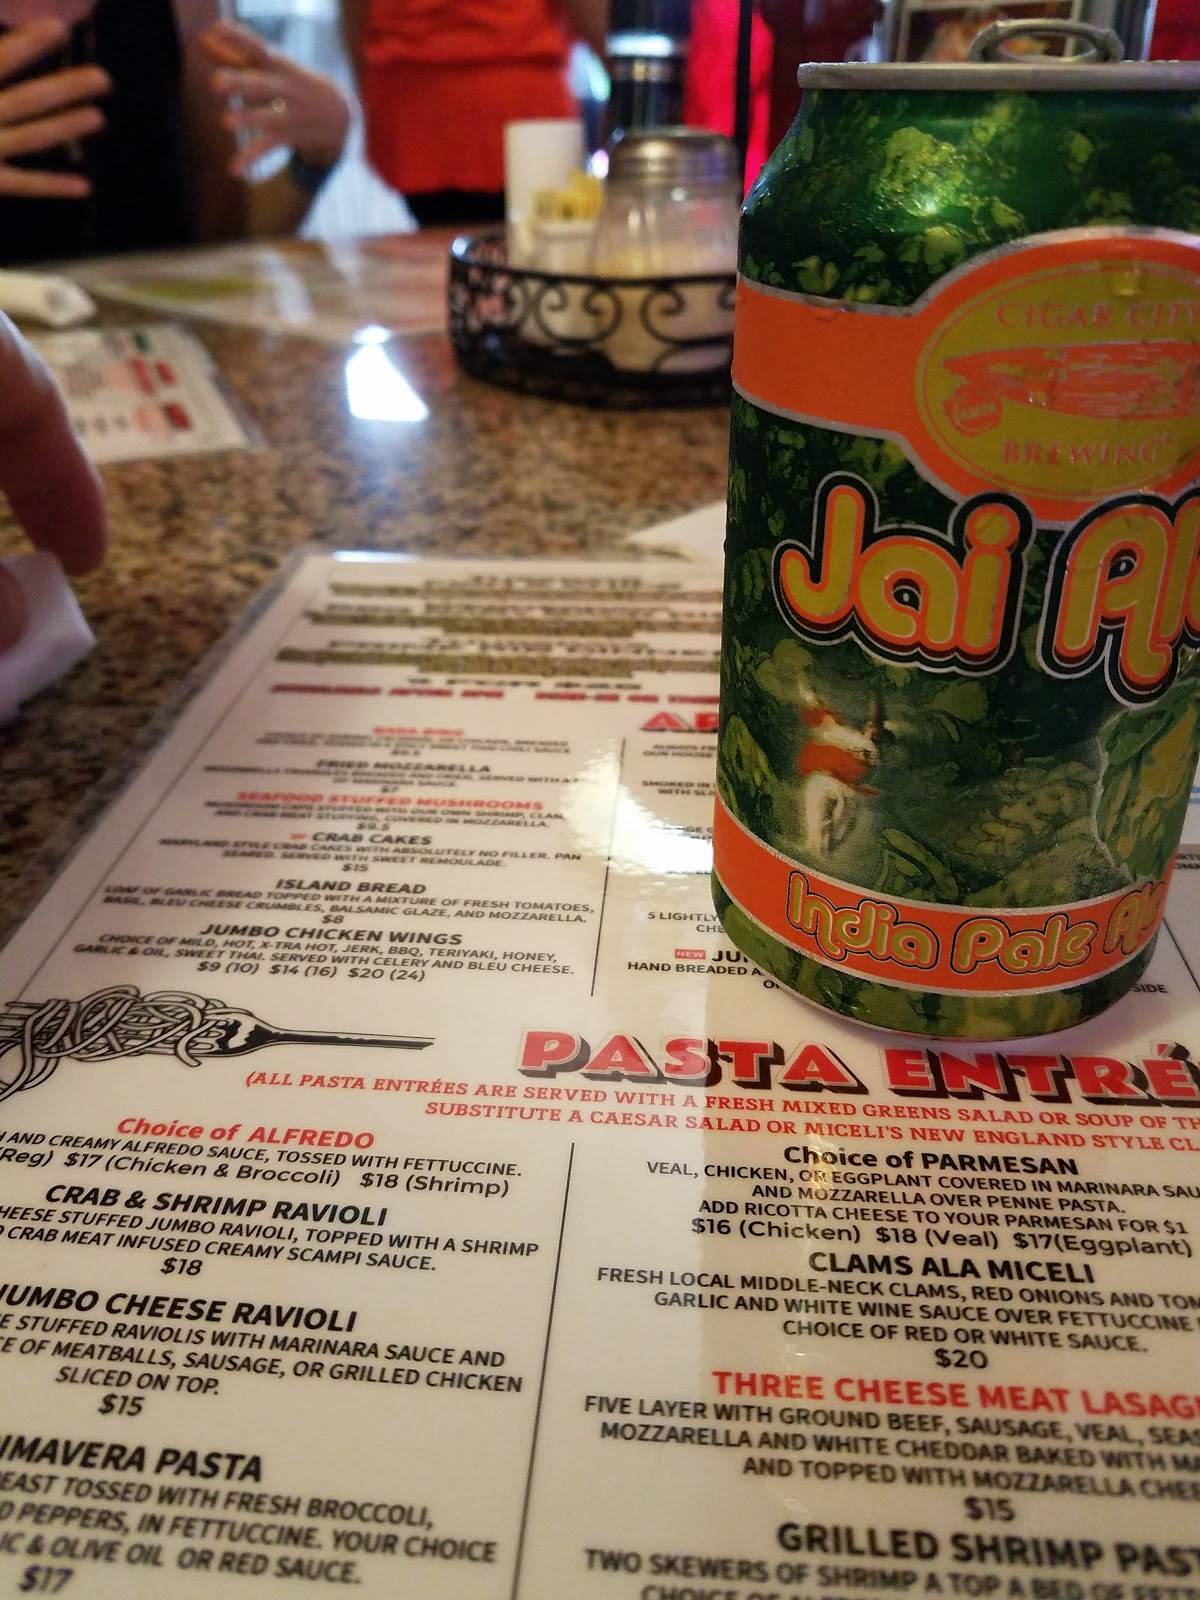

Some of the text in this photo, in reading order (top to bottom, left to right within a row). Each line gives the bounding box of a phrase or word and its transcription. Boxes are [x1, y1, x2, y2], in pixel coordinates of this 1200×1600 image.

[996, 302, 1114, 330] CIGAR
[774, 473, 1200, 707] Jai Al
[237, 791, 544, 810] SEAFOOD STUFFED MUSHROOMS
[312, 832, 432, 845] CRAB CAKES
[276, 878, 426, 894] ISLAND BREAD
[189, 899, 242, 909] CHEESE
[246, 901, 325, 913] CRUMBLES,
[329, 903, 398, 915] BALSAMIC
[402, 907, 451, 918] GLAZE,
[455, 909, 484, 919] AND
[488, 910, 586, 923] MOZZARELLA.
[321, 914, 344, 924] $8
[660, 911, 717, 922] LIGHTLY
[787, 870, 940, 961] India
[948, 912, 1098, 975] Pale
[99, 934, 557, 963] CHOICE OF MILD, HOT, X-TRA HOT, JERK, BBQ, TERIYAKI, HONEY,
[200, 923, 463, 945] JUMBO CHICKEN WINGS
[128, 945, 137, 955] &
[143, 947, 169, 958] OIL,
[174, 948, 224, 958] SWEET
[270, 953, 327, 963] SERVED
[331, 955, 370, 965] WITH
[372, 956, 430, 967] CELERY
[432, 959, 463, 969] AND
[467, 961, 507, 971] BLEU
[511, 963, 574, 975] CHEESE.
[197, 961, 425, 982] $9 (10) $14 (16) $20 (24)
[628, 961, 747, 976] HAND BREADED
[517, 1030, 1200, 1108] PASTA ENTRÉ
[246, 1071, 293, 1088] (ALL
[299, 1074, 366, 1090] PASTA
[372, 1078, 468, 1096] ENTRÉES
[473, 1083, 517, 1098] ARE
[523, 1086, 607, 1103] SERVED
[614, 1091, 676, 1107] WITH
[681, 1094, 699, 1108] A
[705, 1096, 775, 1112] FRESH
[782, 1100, 857, 1116] MIXED
[862, 1103, 951, 1121] GREENS
[957, 1108, 1034, 1124] SALAD
[1039, 1112, 1068, 1126] OR
[1075, 1113, 1134, 1128] SOUP
[1139, 1115, 1167, 1129] OF
[117, 1117, 375, 1149] Choice of ALFREDO
[425, 1101, 1200, 1152] SUBSTITUTE A CAESAR SALAD OR MICELI'S NEW ENGLAND STYLE CL
[9, 1131, 46, 1146] AND
[48, 1135, 120, 1151] CREAMY
[121, 1139, 203, 1157] ALFREDO
[206, 1146, 269, 1164] SAUCE,
[277, 1150, 347, 1165] TOSSED
[351, 1154, 398, 1169] WITH
[403, 1157, 522, 1176] FETTUCCINE.
[784, 1146, 1078, 1175] Choice of PARMESAN
[64, 1153, 102, 1168] $17
[105, 1155, 207, 1177] (Chicken
[214, 1163, 229, 1177] &
[236, 1164, 340, 1187] Broccoli)
[360, 1172, 398, 1188] $18
[405, 1174, 509, 1198] (Shrimp)
[646, 1161, 698, 1178] VEAL,
[704, 1165, 794, 1183] CHICKEN,
[799, 1170, 826, 1183] OR
[833, 1171, 932, 1187] EGGPLANT
[938, 1176, 1026, 1192] COVERED
[1032, 1179, 1052, 1192] IN
[1057, 1182, 1159, 1197] MARINARA
[45, 1184, 387, 1226] CRAB & SHRIMP RAVIOLI
[0, 1205, 539, 1257] HEESE STUFFED JUMBO RAVIOLI, TOPPED WITH A SHRIMP
[692, 1218, 1192, 1257] $16 (Chicken) $18 (Veal) $17(Eggplant)
[160, 1257, 202, 1276] $18
[809, 1252, 1095, 1283] CLAMS ALA MICELI
[105, 1292, 227, 1322] CHEESE
[231, 1302, 357, 1333] RAVIOLI
[934, 1349, 988, 1369] $20
[97, 1393, 145, 1416] $15
[712, 1371, 1200, 1420] THREE CHEESE MEAT LASAG
[0, 1435, 262, 1482] IMAVERA PASTA
[777, 1521, 938, 1560] GRILLED
[950, 1531, 1104, 1570] SHRIMP
